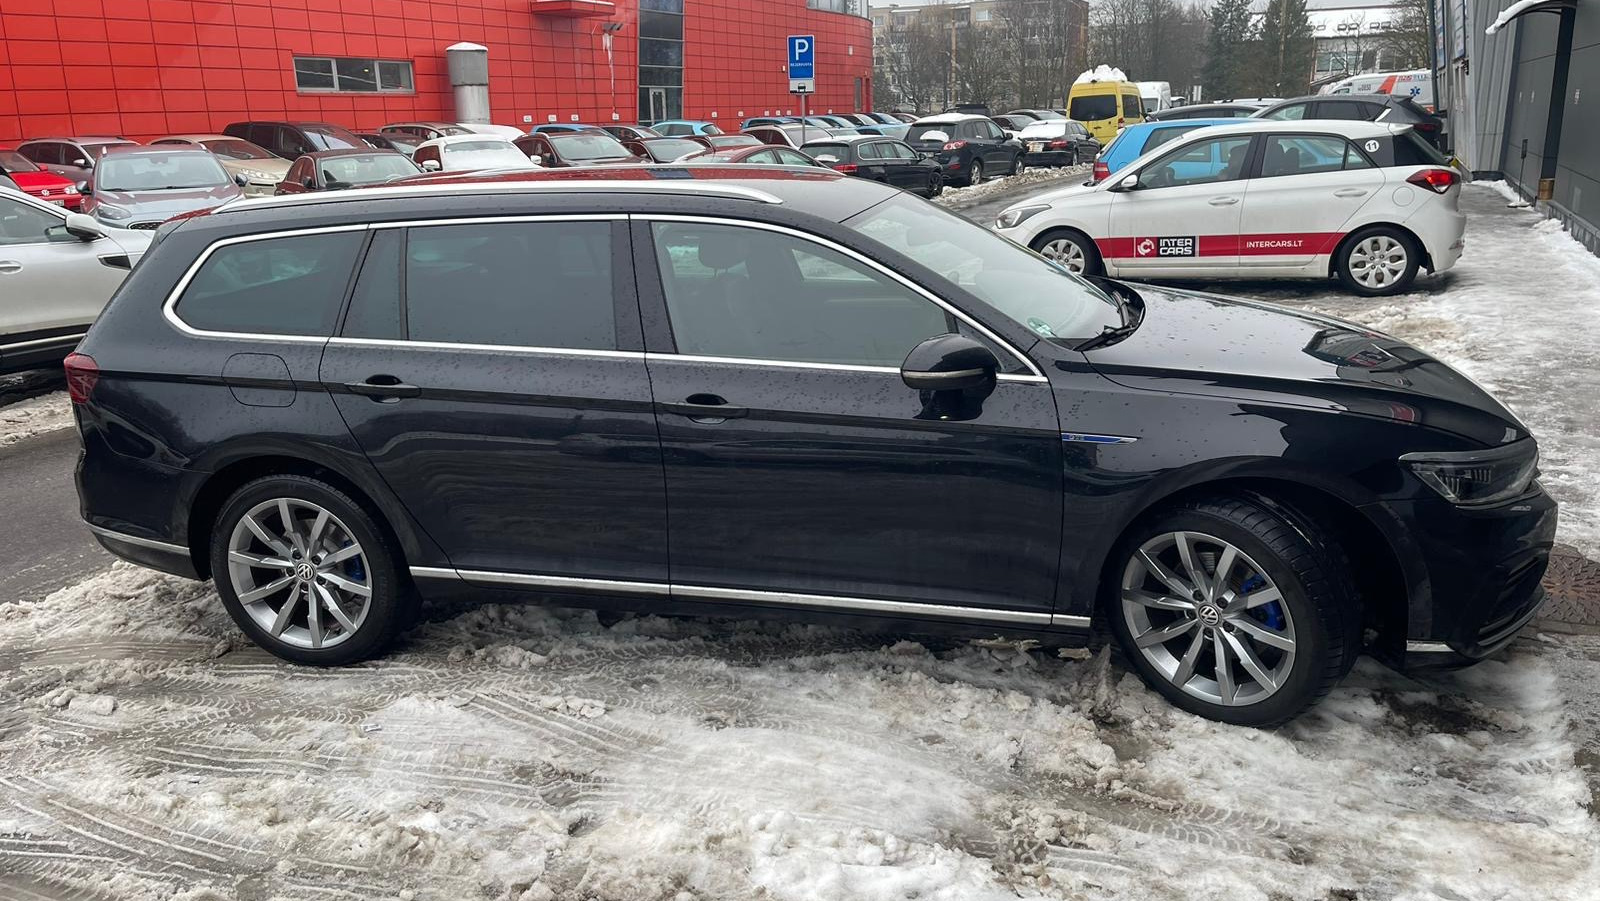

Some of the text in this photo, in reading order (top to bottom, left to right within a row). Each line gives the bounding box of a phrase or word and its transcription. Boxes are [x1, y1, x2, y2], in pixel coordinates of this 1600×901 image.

[795, 39, 809, 60] P
[1366, 142, 1377, 151] 11
[1159, 238, 1193, 247] INTER
[1246, 239, 1303, 248] INTERCARS.LT
[1159, 246, 1193, 255] CARS
